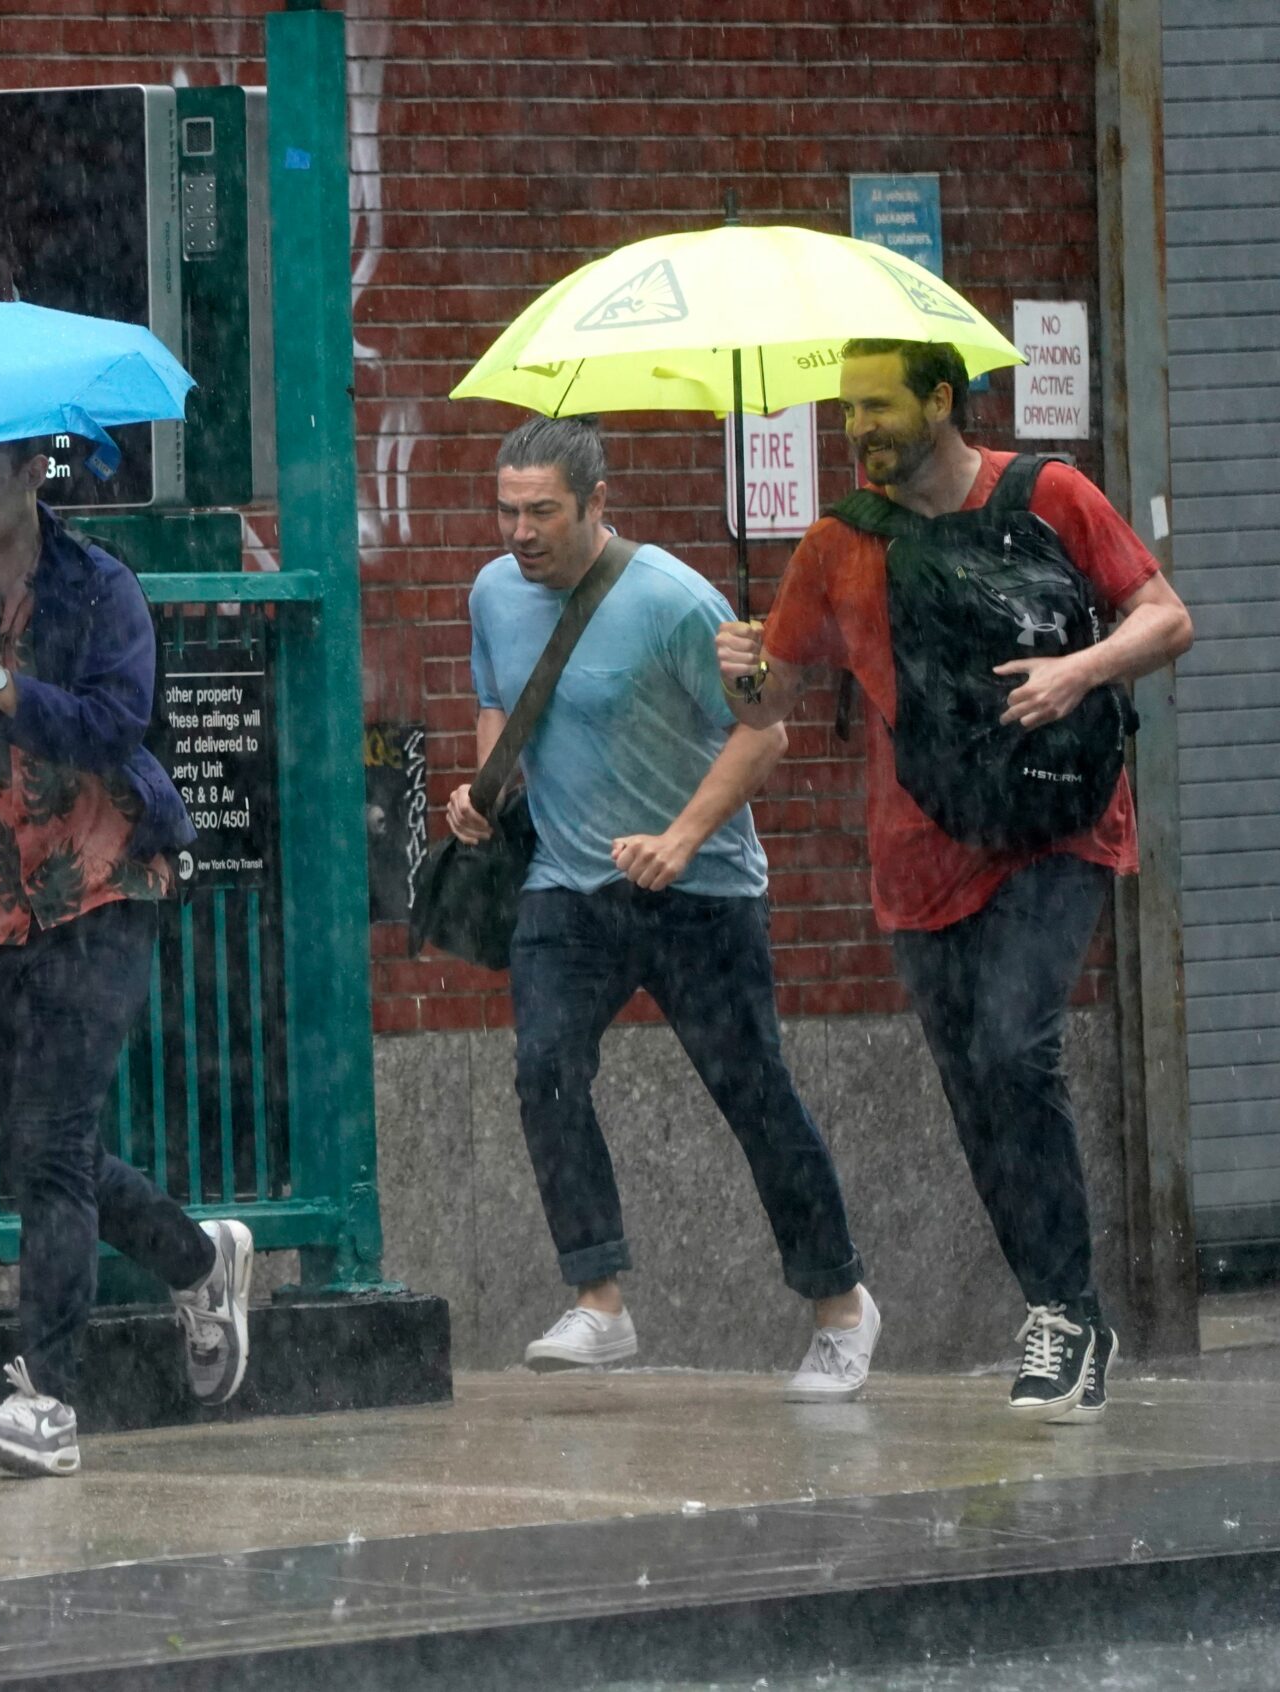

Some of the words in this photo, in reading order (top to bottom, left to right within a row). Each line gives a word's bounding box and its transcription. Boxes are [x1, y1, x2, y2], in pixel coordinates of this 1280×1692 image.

[1042, 316, 1061, 335] NO
[1024, 344, 1081, 365] STANDING
[1030, 376, 1074, 395] ACTIVE
[1024, 406, 1080, 425] DRIVEWAY
[750, 433, 794, 469] FIRE
[747, 482, 799, 517] ZONE
[166, 685, 193, 703] other
[197, 684, 243, 706] property
[169, 711, 199, 728] these
[202, 709, 240, 731] railings
[243, 709, 261, 727] will
[194, 735, 242, 753] delivered
[247, 735, 258, 751] to
[202, 760, 223, 778] Unit
[181, 786, 193, 803] St
[197, 786, 206, 803] &
[210, 785, 218, 803] 8
[222, 785, 235, 802] Av
[211, 859, 226, 870] York
[226, 858, 240, 872] City
[240, 858, 263, 869] Transit
